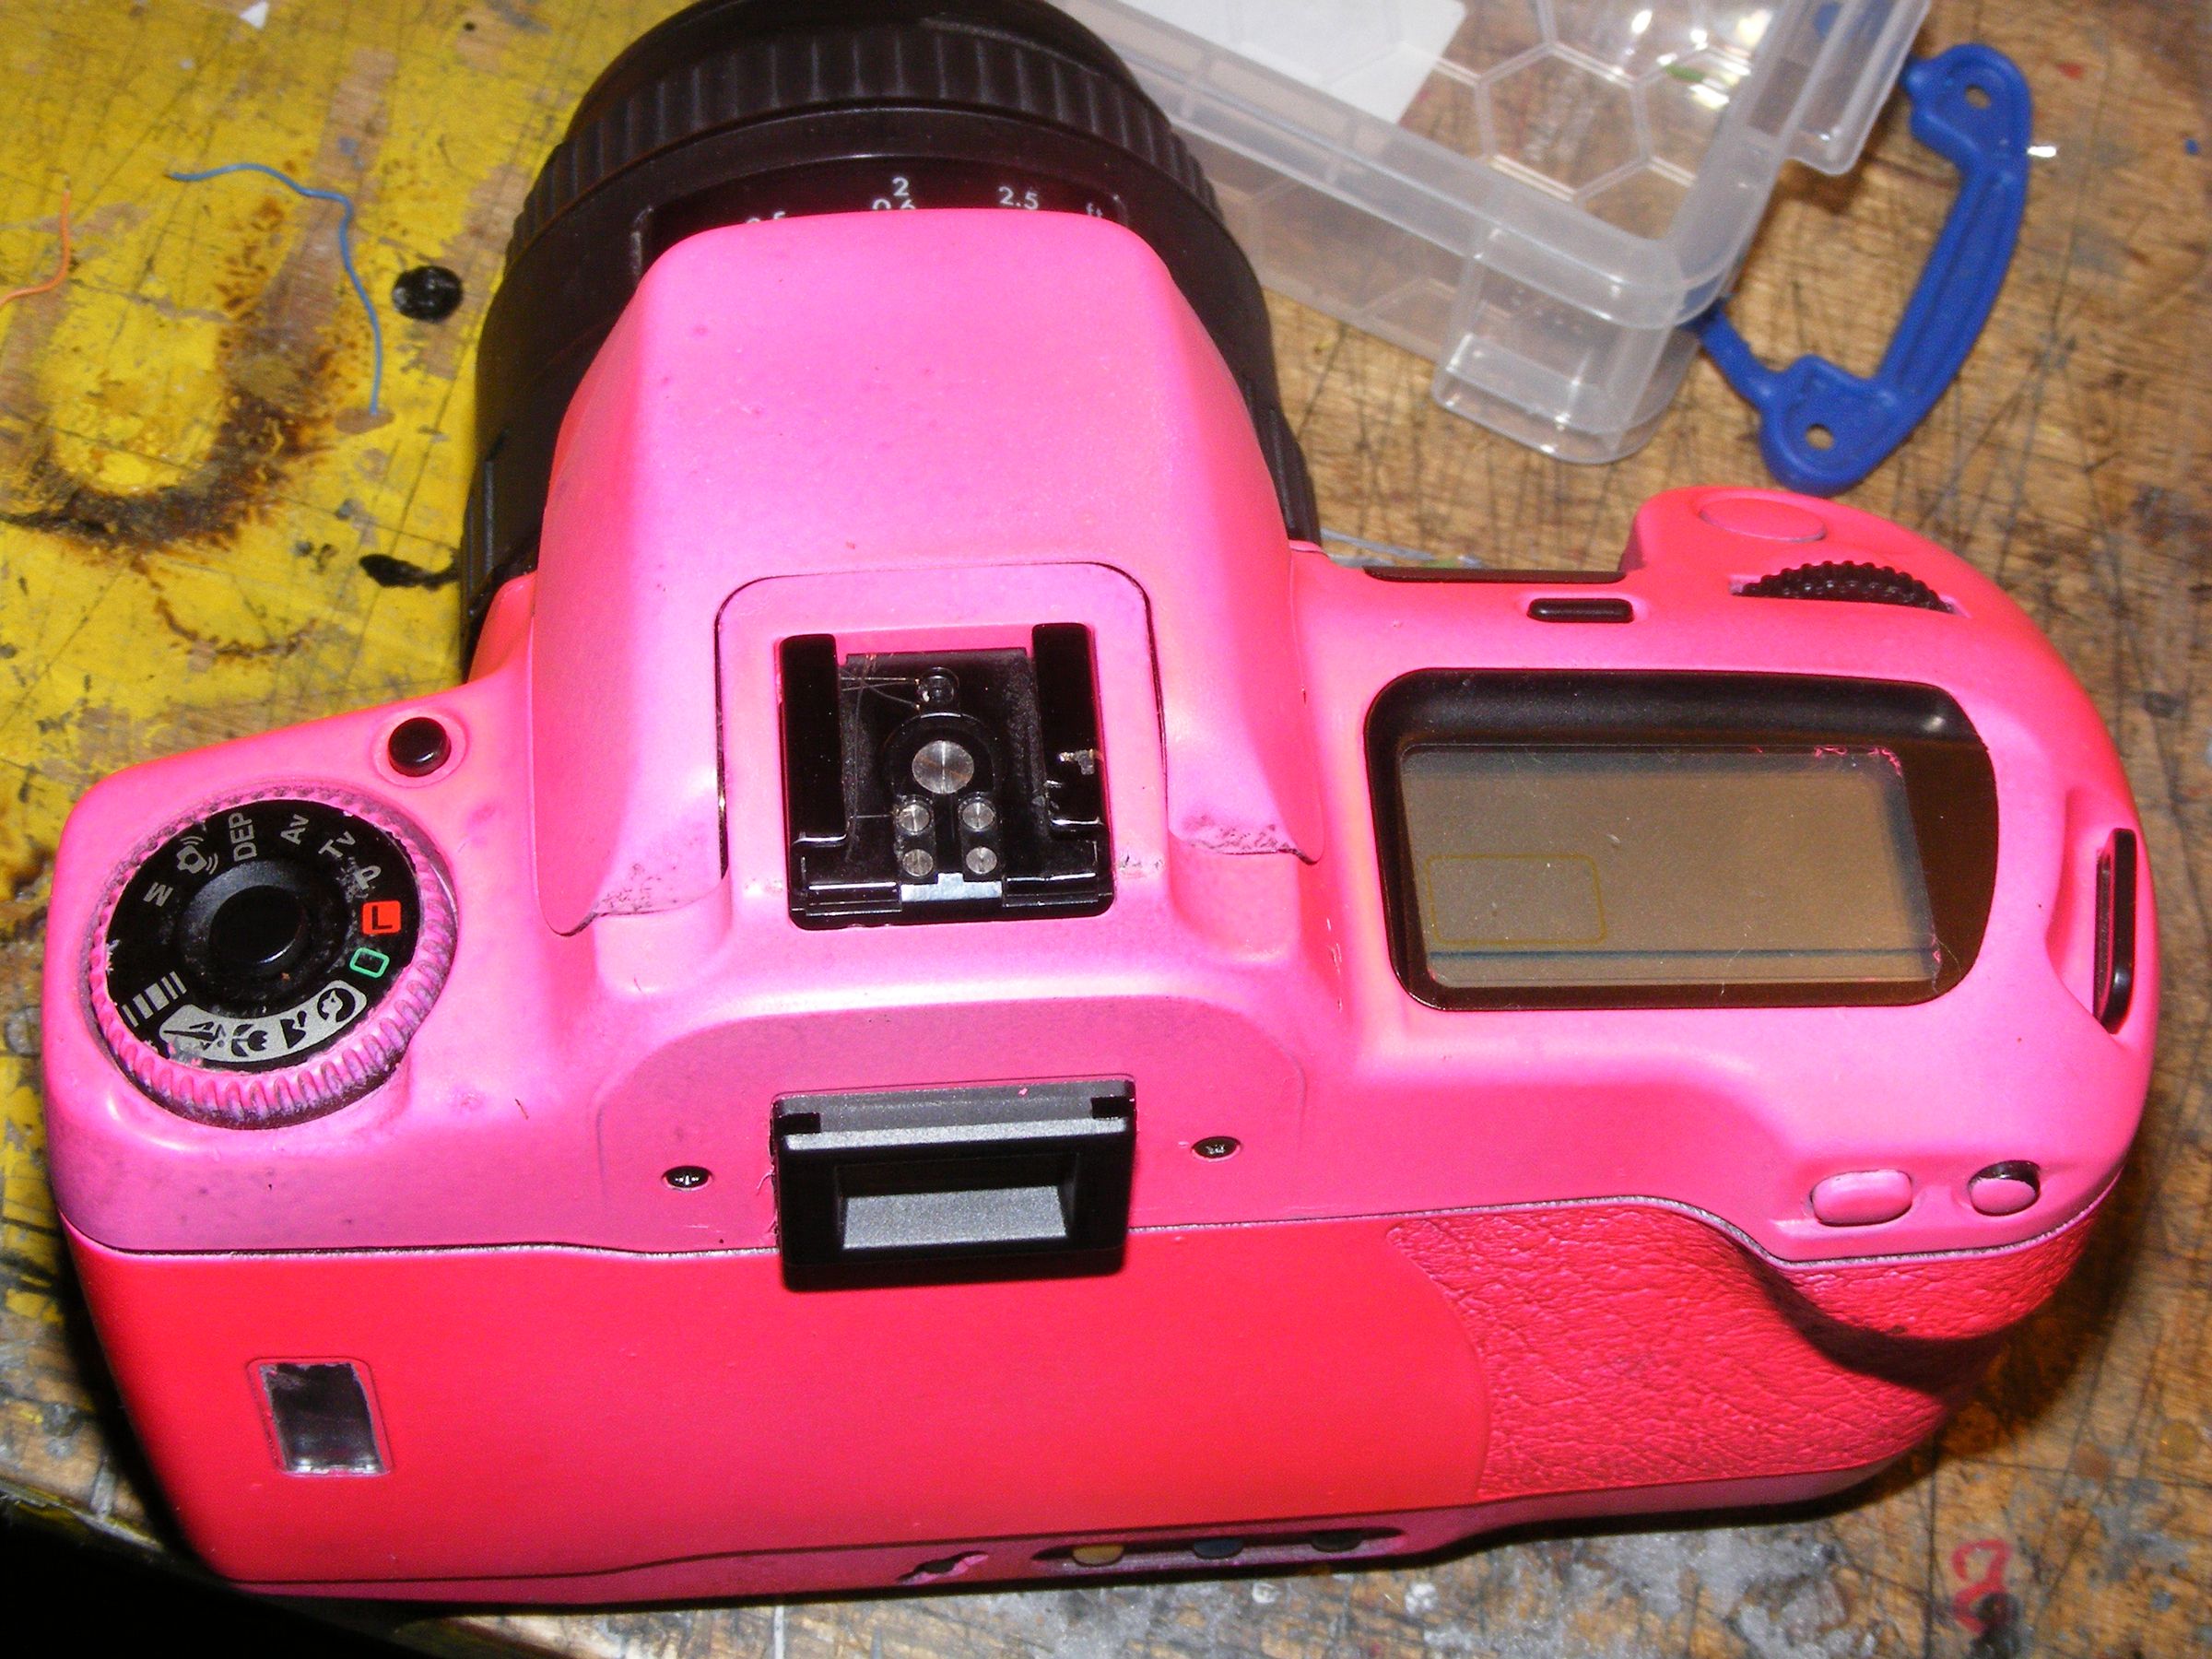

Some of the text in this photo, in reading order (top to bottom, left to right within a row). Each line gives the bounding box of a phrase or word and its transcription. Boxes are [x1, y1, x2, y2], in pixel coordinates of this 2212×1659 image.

[891, 176, 910, 196] 2
[998, 186, 1039, 210] 2.5
[228, 812, 258, 862] DEP
[318, 830, 356, 858] Tv
[353, 865, 382, 890] P
[371, 905, 394, 930] L
